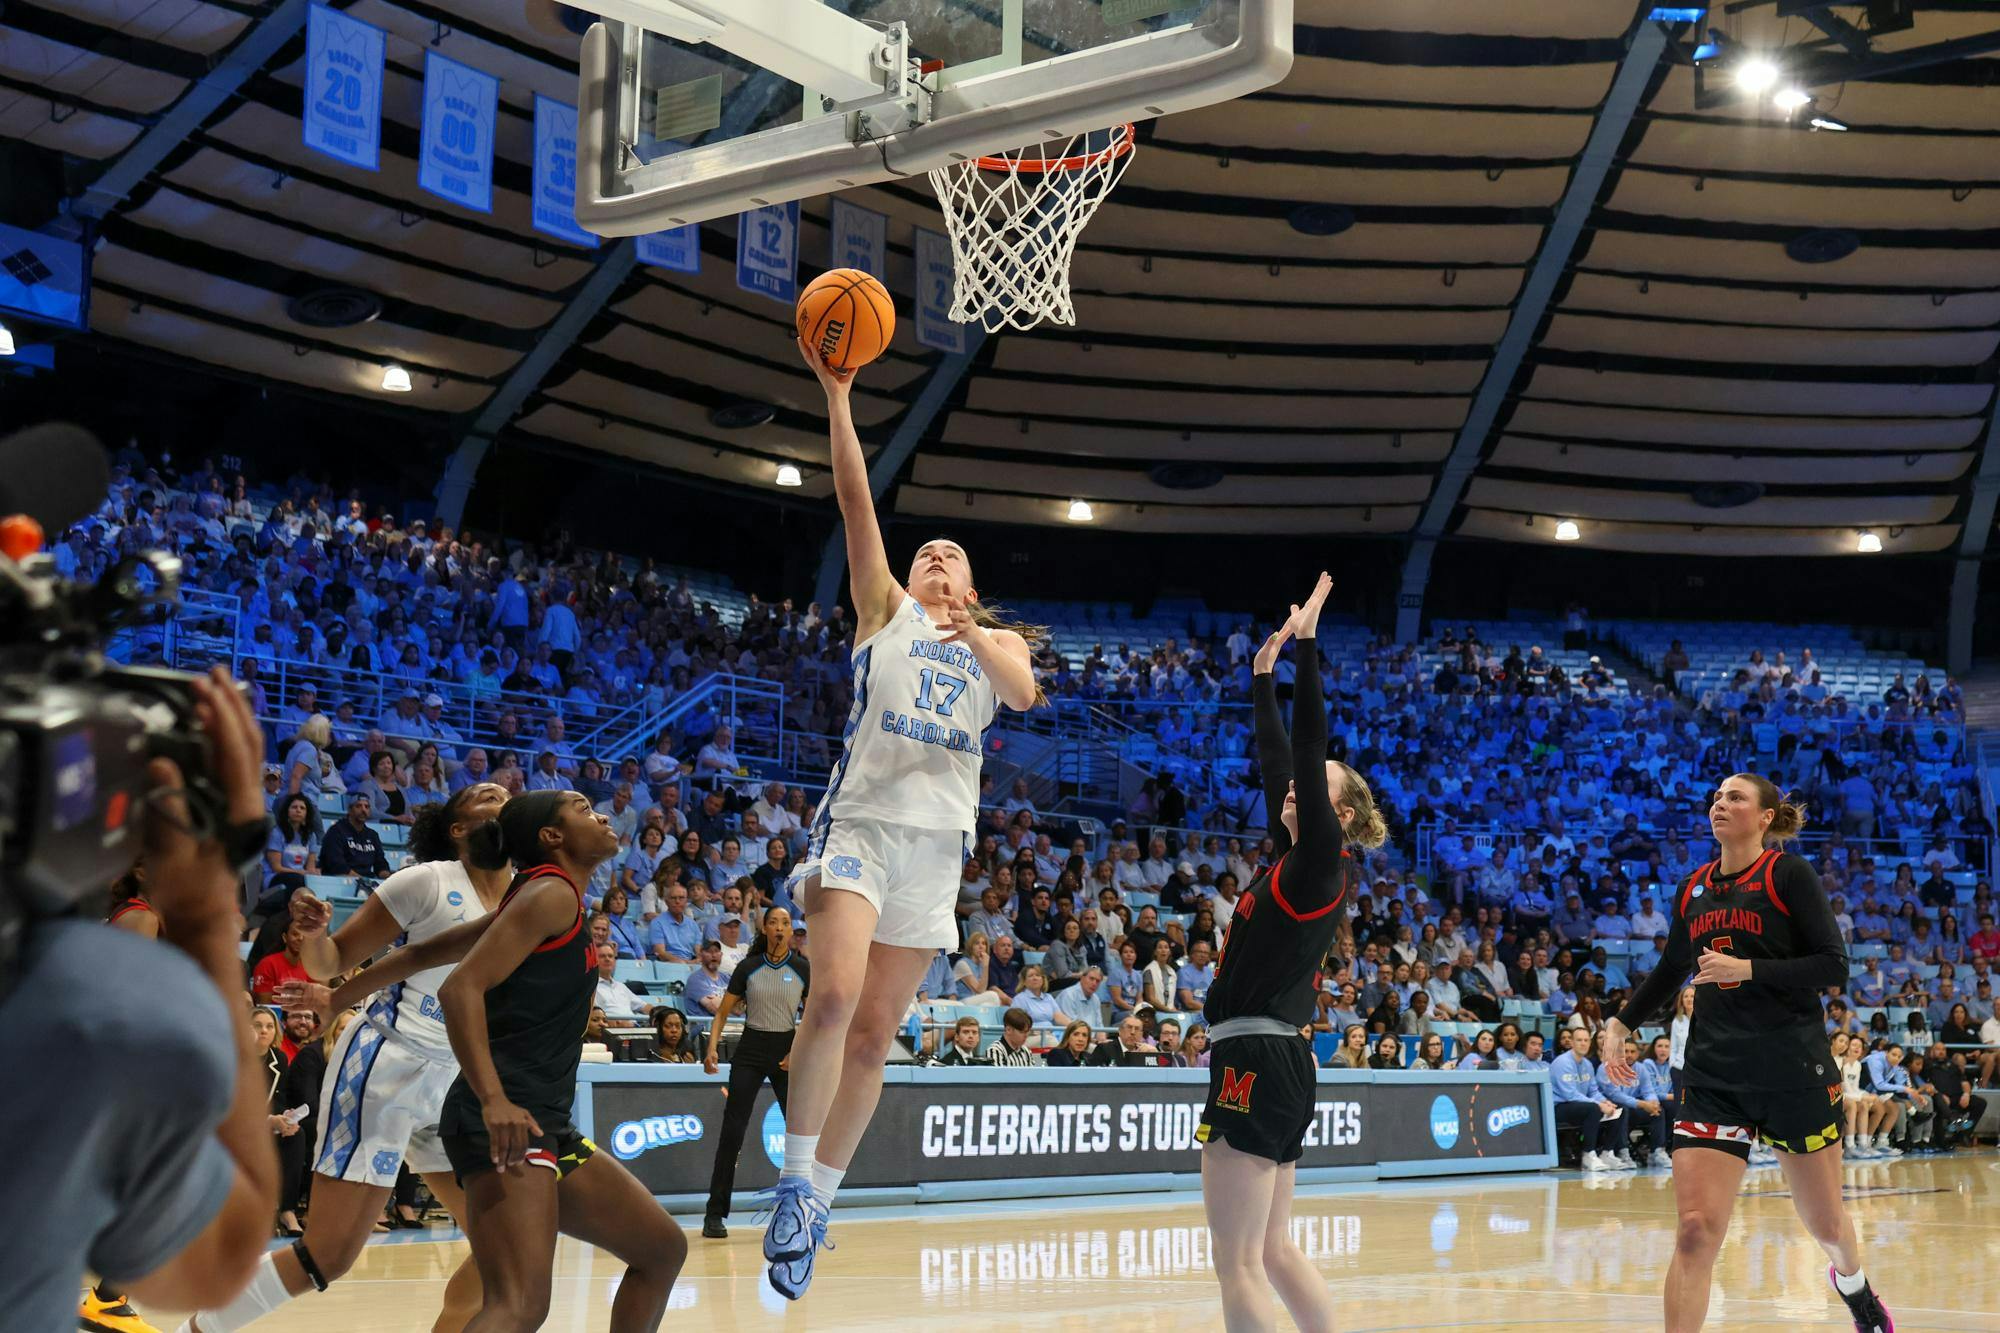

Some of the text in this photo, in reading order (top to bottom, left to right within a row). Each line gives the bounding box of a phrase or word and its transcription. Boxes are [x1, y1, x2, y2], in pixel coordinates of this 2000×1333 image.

[324, 68, 361, 110] 20
[758, 219, 782, 254] 12
[753, 271, 781, 292] LATTA
[222, 455, 242, 471] 212
[909, 639, 982, 681] NORTH
[915, 667, 967, 717] 17
[881, 710, 982, 756] CAROLINA
[1476, 837, 1491, 848] 110
[1689, 907, 1764, 943] MARYLAND
[1217, 1066, 1257, 1108] M
[613, 1116, 702, 1157] OREO
[922, 1101, 1362, 1158] CELEBRATES STUDE ETES
[1488, 1105, 1530, 1135] OREO
